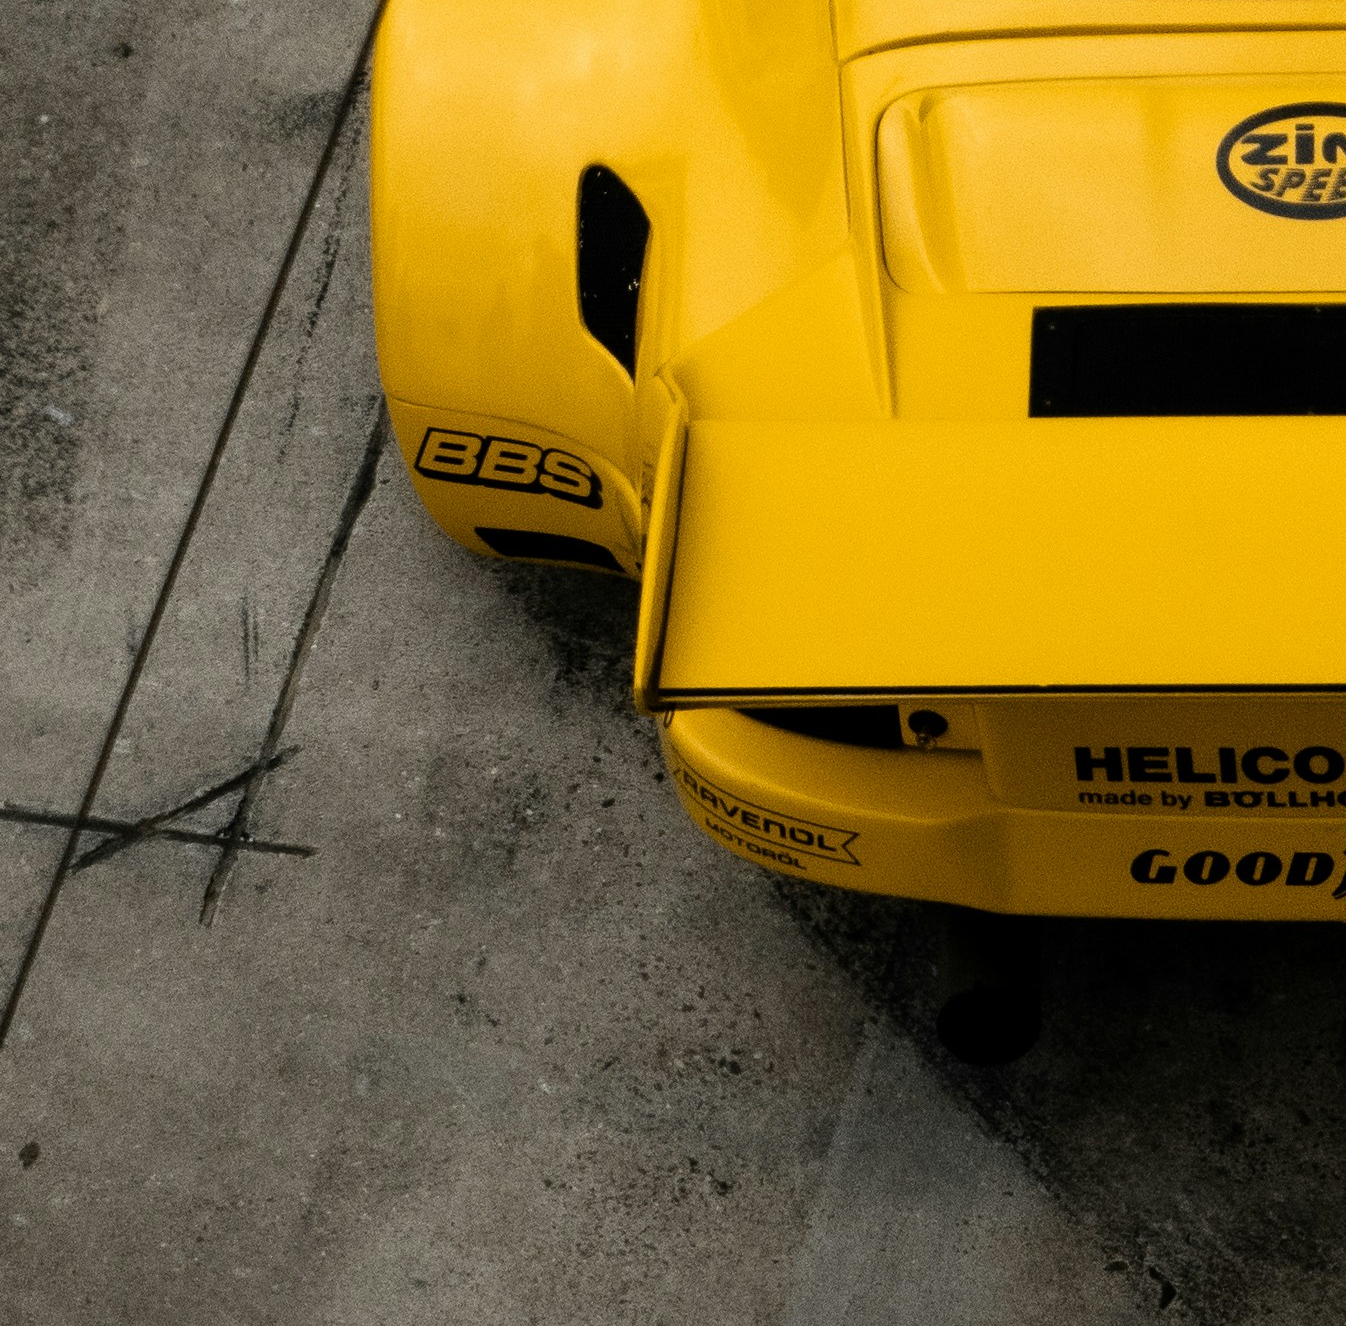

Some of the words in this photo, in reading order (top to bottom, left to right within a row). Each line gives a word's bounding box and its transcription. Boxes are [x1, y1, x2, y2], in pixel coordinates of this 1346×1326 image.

[414, 426, 603, 510] BBS
[683, 769, 840, 853] RAVENOL
[1078, 790, 1152, 807] made
[1160, 790, 1192, 810] by
